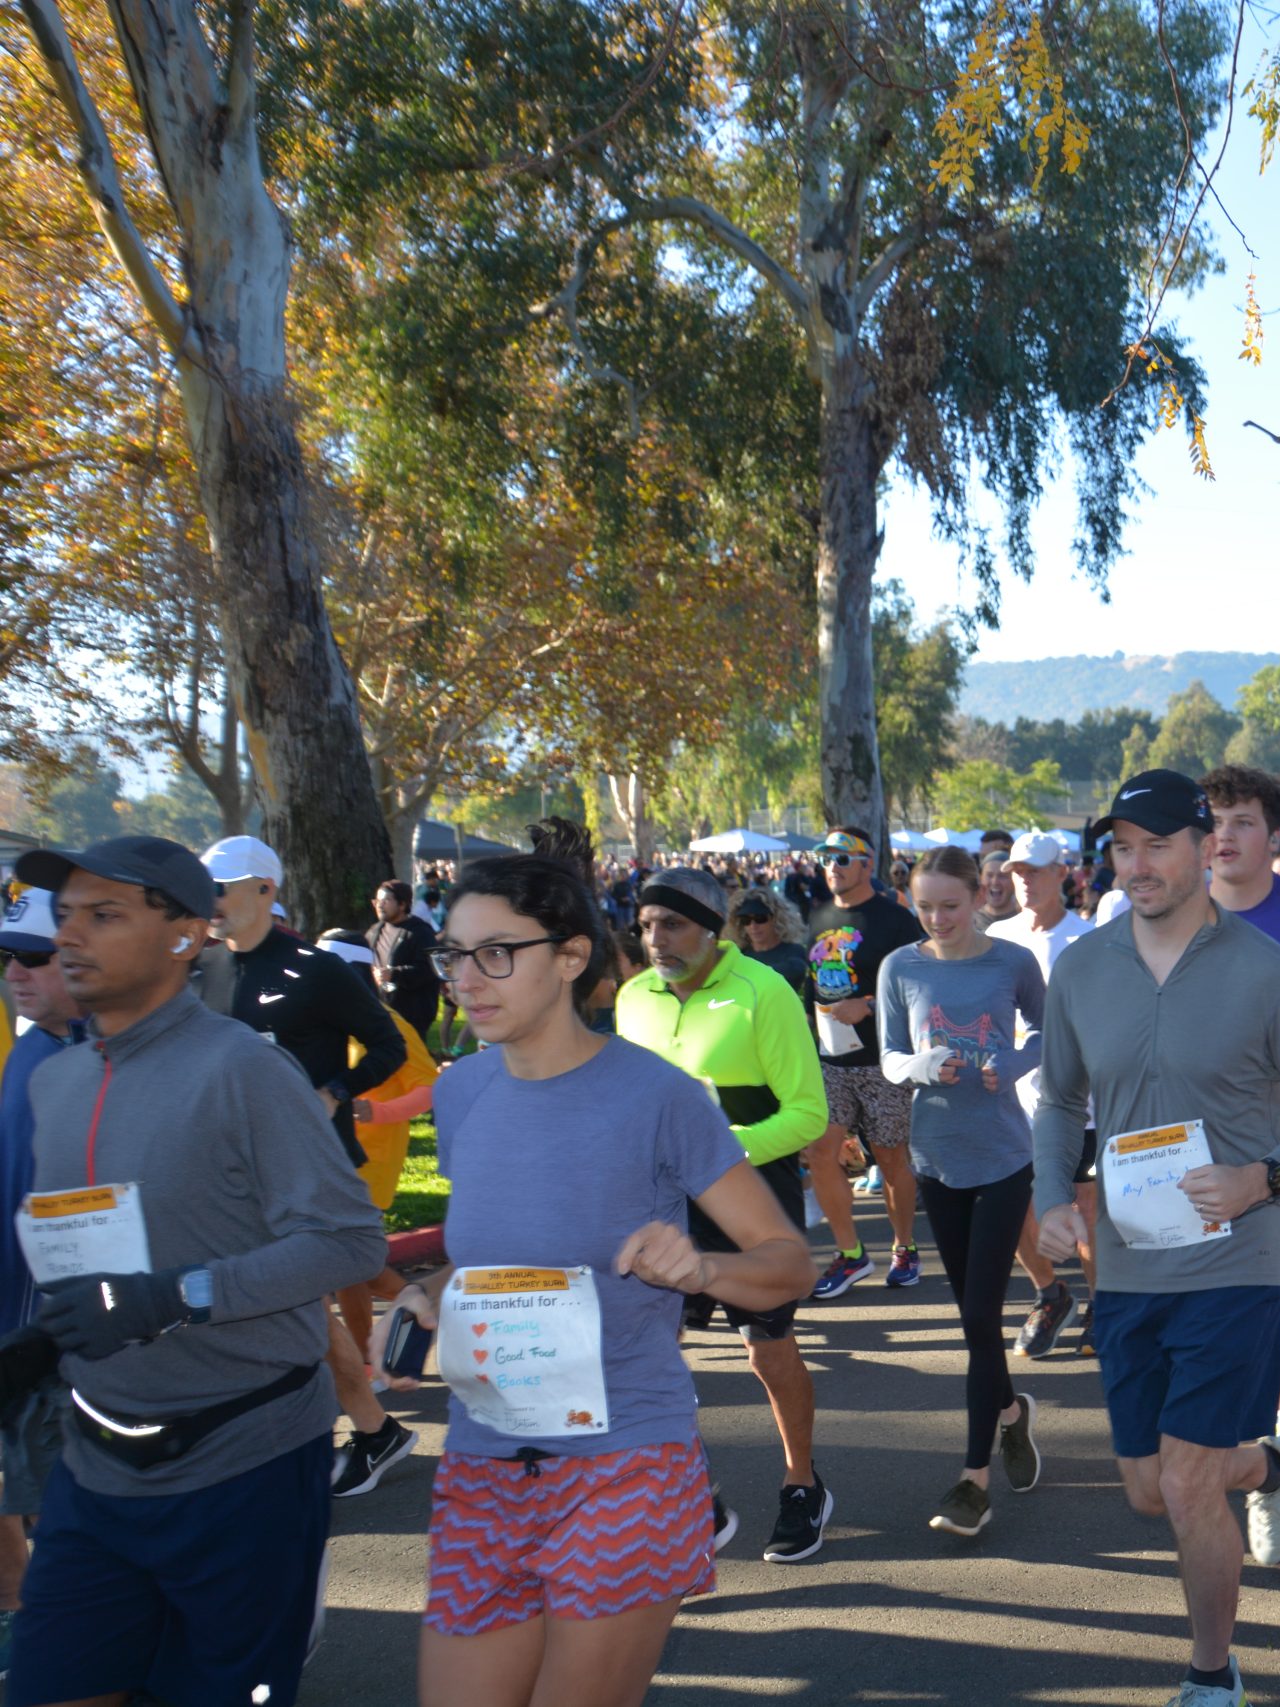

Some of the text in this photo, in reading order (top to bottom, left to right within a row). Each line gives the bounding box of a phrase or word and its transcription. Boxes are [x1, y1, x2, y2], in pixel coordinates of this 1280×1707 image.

[1117, 1158, 1130, 1167] am
[1130, 1149, 1167, 1164] thankful
[1168, 1146, 1182, 1156] for
[46, 1217, 89, 1232] thankful
[91, 1215, 109, 1226] for
[503, 1271, 537, 1280] ANNUAL
[507, 1281, 541, 1289] TURKEY
[543, 1280, 565, 1288] BURN
[459, 1301, 478, 1311] am
[481, 1296, 534, 1310] thankful
[538, 1295, 558, 1307] for
[490, 1319, 541, 1338] Family
[494, 1346, 557, 1365] Good Food
[495, 1374, 542, 1390] Books
